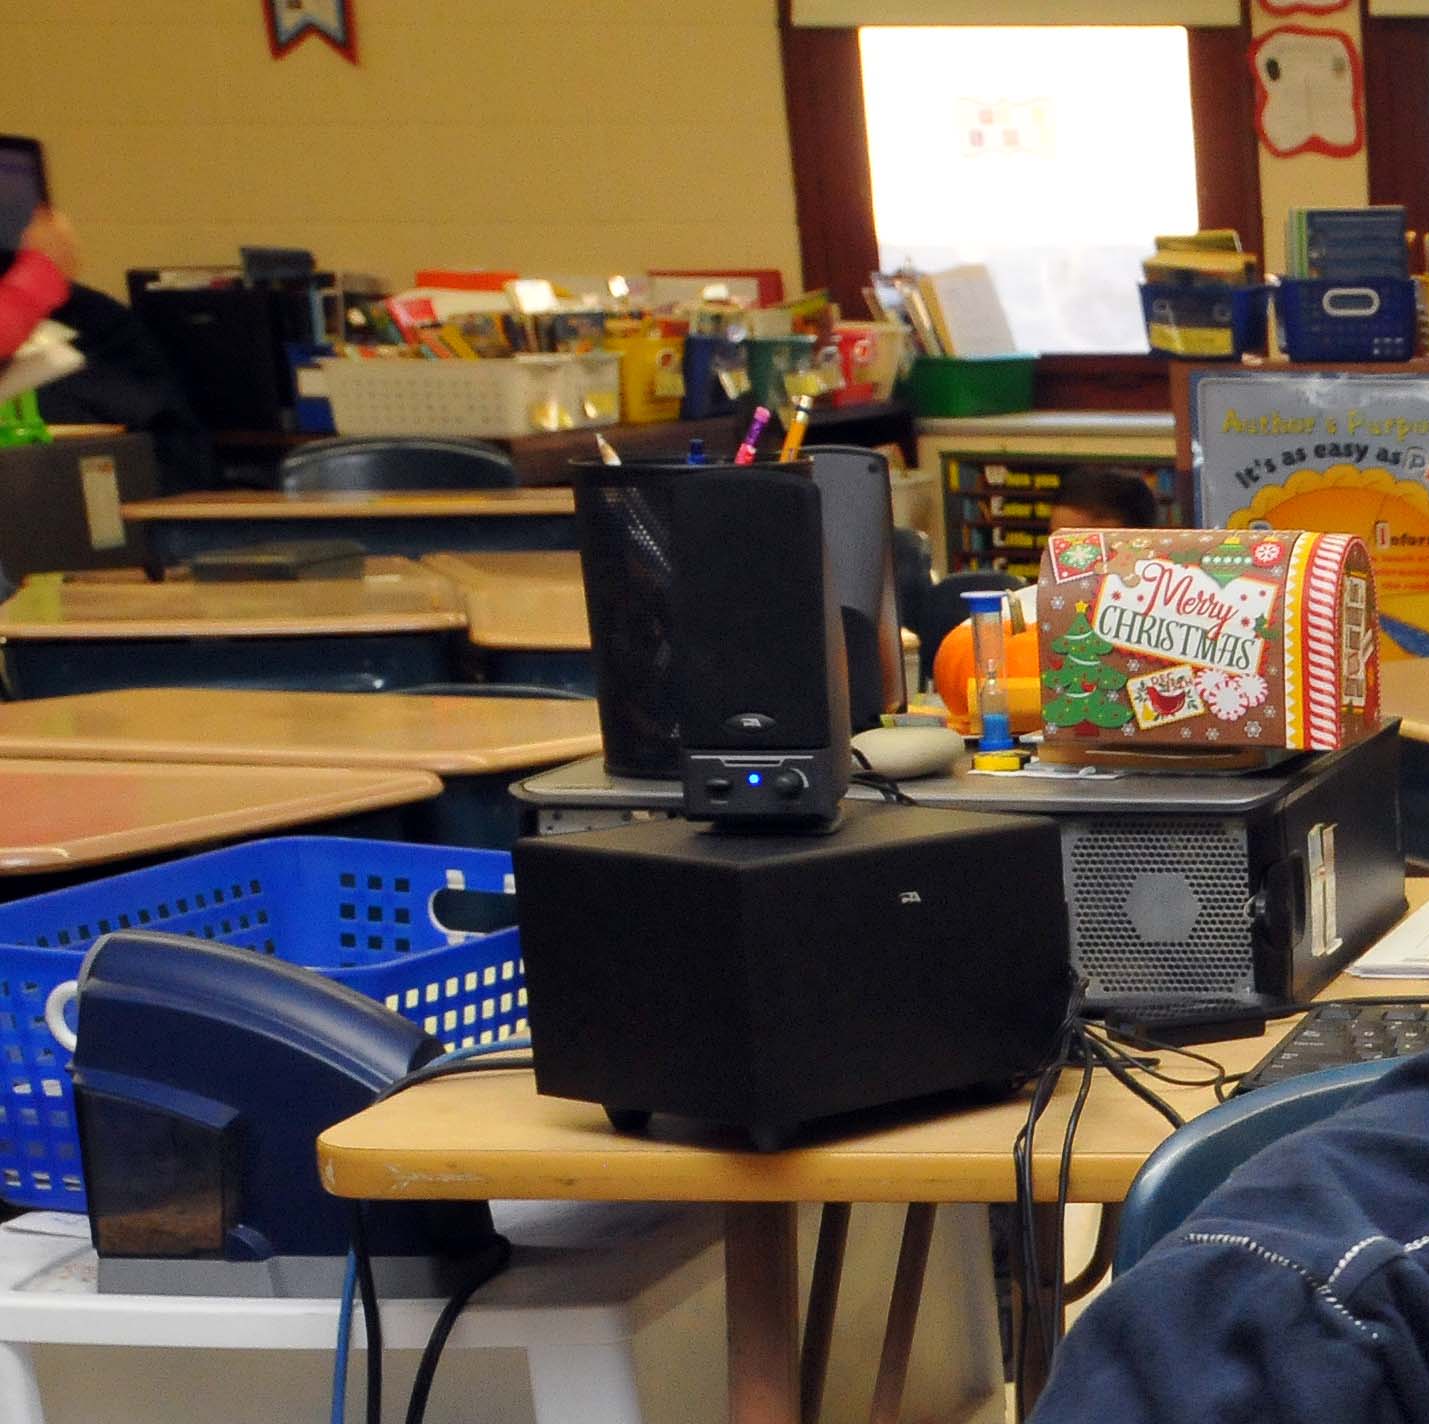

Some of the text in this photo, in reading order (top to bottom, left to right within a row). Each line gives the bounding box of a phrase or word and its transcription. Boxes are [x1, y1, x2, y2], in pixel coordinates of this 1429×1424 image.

[1234, 456, 1277, 489] It's
[1281, 447, 1307, 467] as
[1313, 442, 1369, 463] easy
[1376, 447, 1402, 465] as
[1142, 562, 1240, 642] Merry
[1098, 604, 1256, 671] CHRISTMAS
